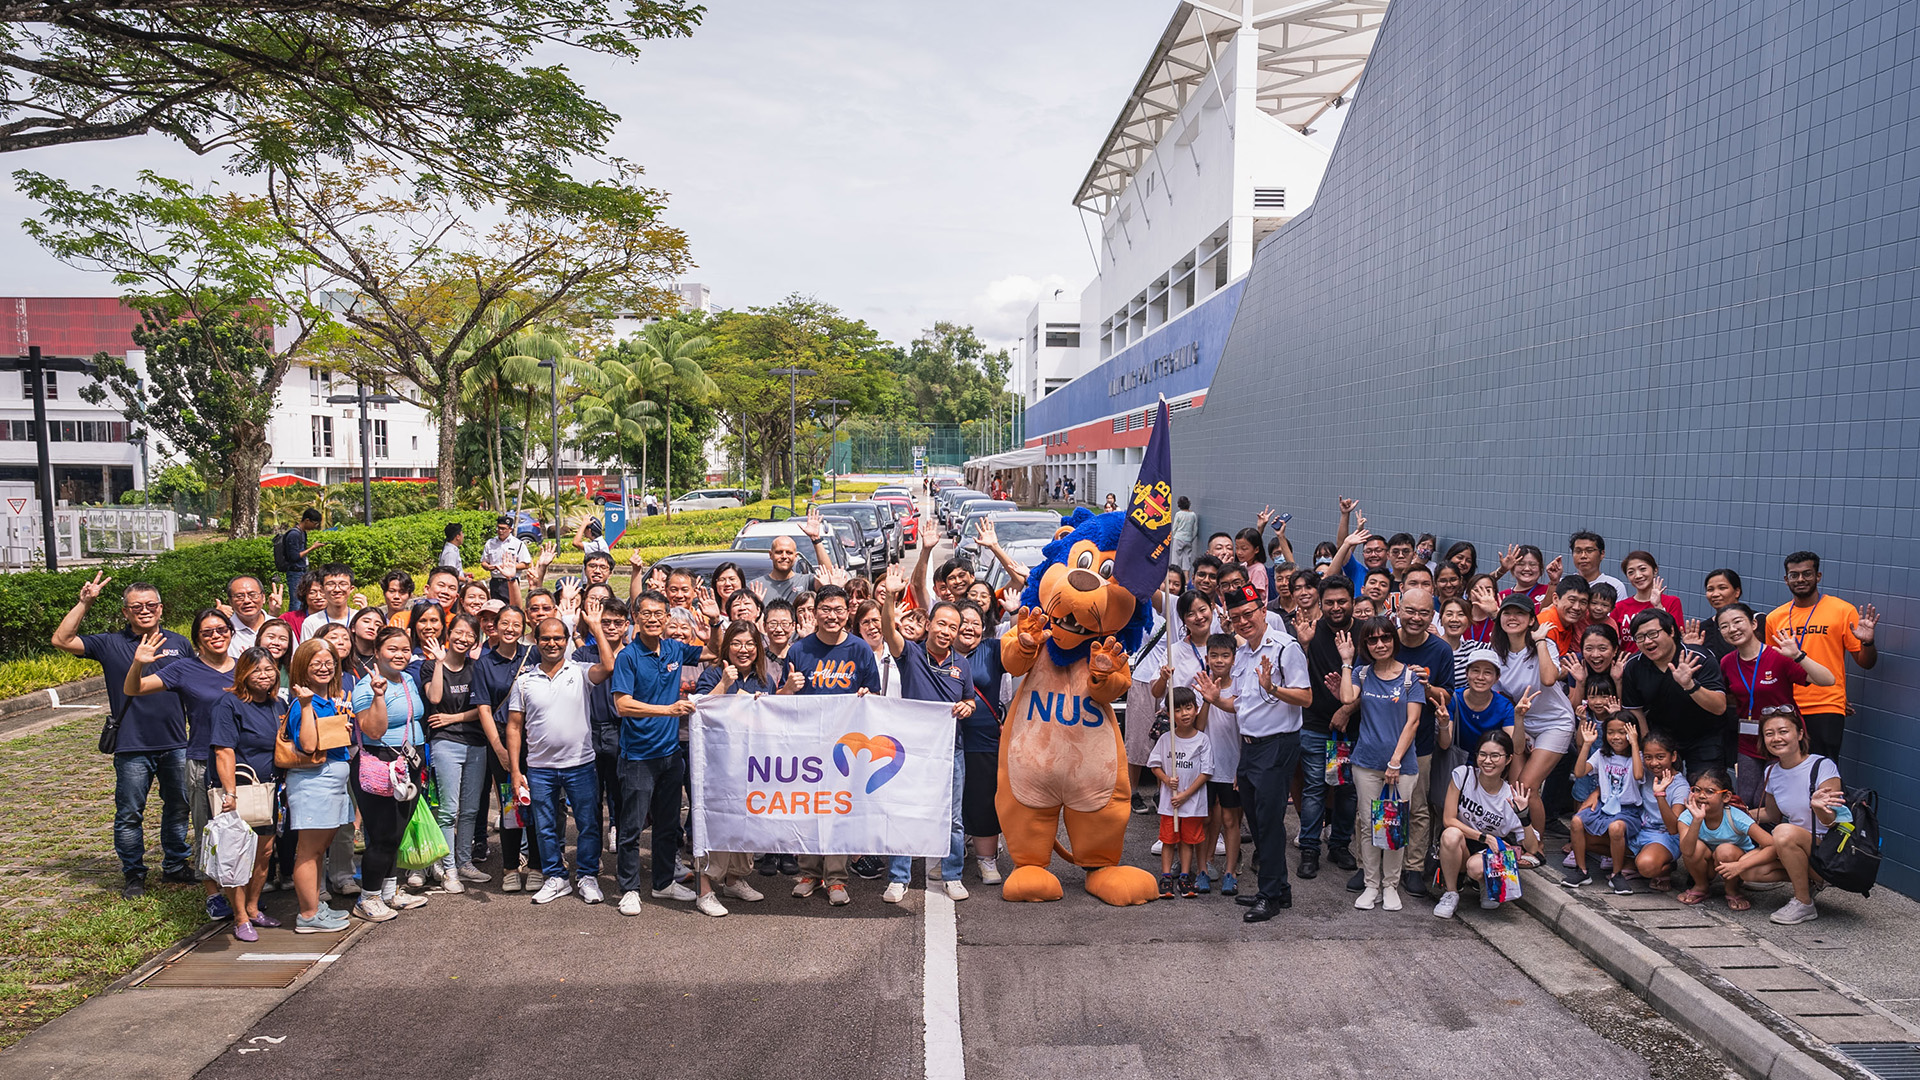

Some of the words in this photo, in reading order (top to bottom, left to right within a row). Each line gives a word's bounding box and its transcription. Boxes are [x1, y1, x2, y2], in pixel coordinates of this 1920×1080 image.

[611, 512, 619, 522] 9
[1151, 544, 1164, 559] THE
[812, 659, 856, 689] NUS
[1027, 690, 1104, 728] NUS
[1166, 751, 1186, 760] JMP
[747, 755, 824, 783] NUS
[1175, 760, 1193, 769] HIGH
[746, 790, 853, 815] CARES
[1459, 794, 1484, 817] NUS
[1482, 816, 1501, 828] GRAD
[1485, 810, 1504, 823] POST
